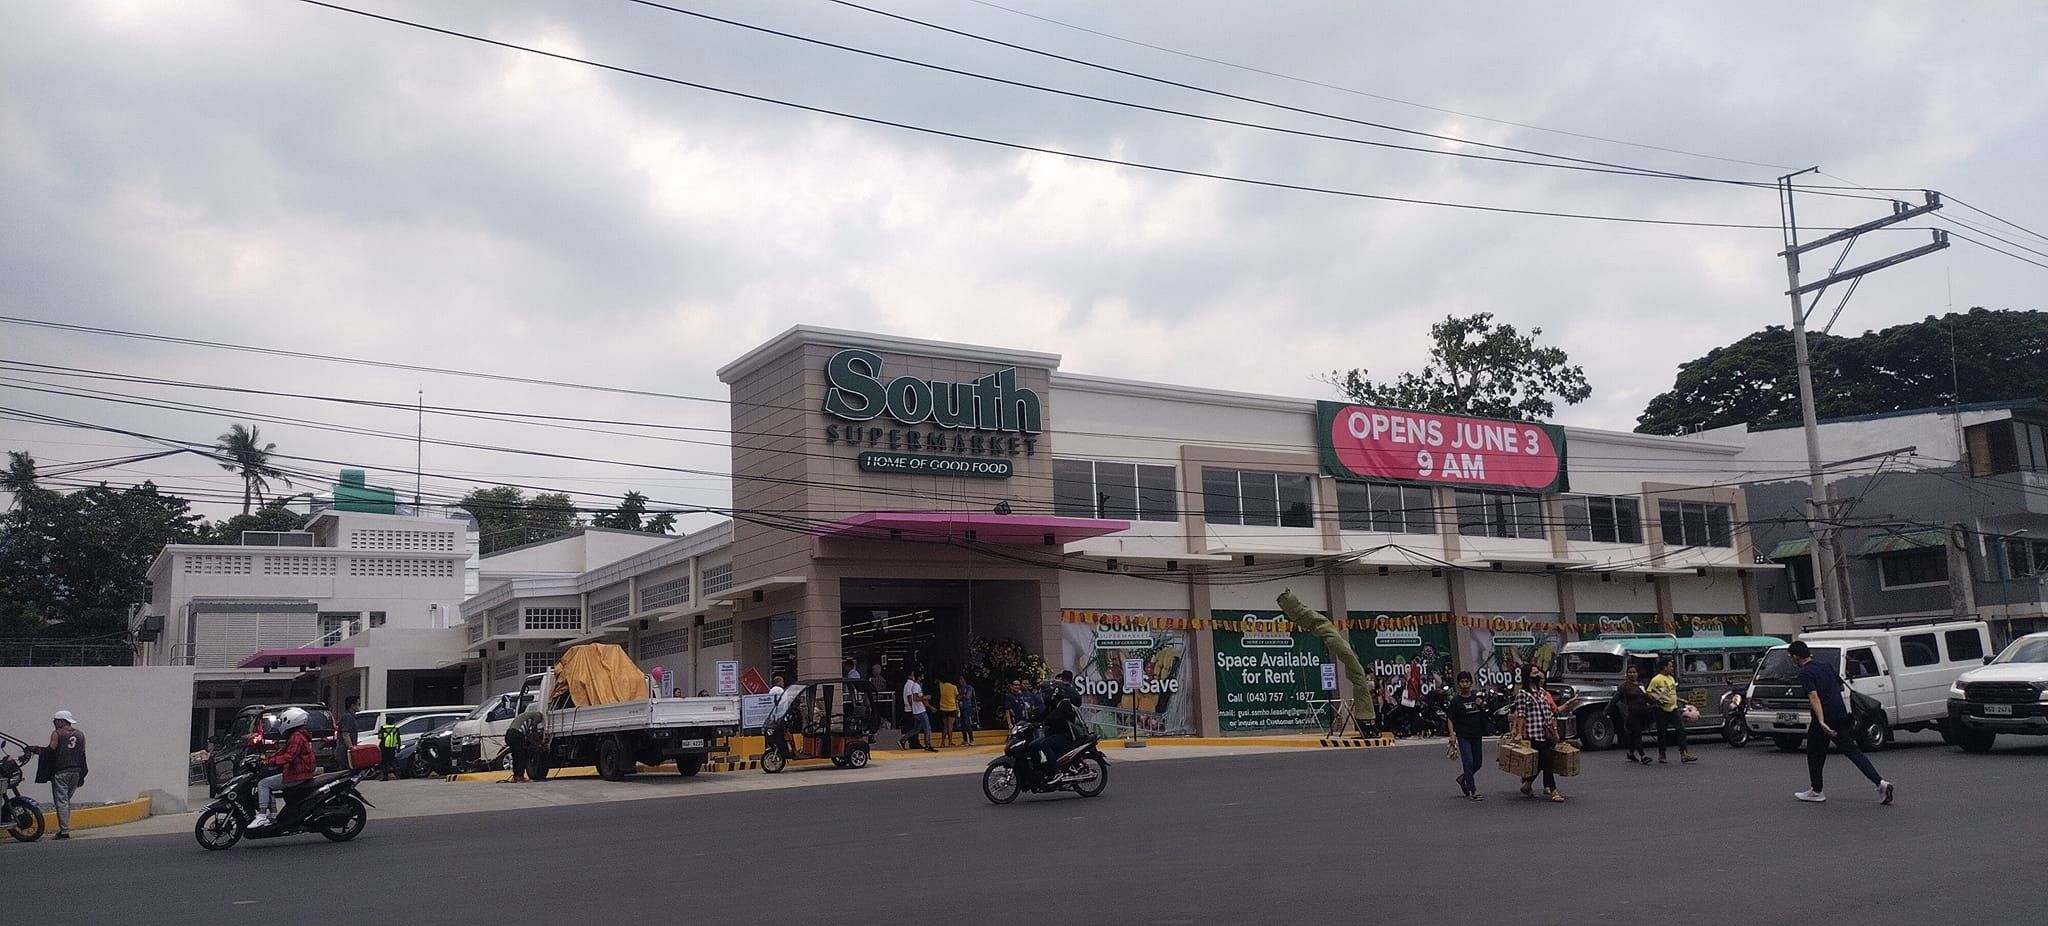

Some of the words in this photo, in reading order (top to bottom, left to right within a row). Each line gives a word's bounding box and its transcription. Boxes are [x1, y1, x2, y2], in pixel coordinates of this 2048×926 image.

[822, 348, 1042, 434] South
[826, 422, 1038, 457] SUPERMARKET
[1348, 412, 1444, 446] OPENS
[1451, 423, 1518, 453] JUNE
[1524, 429, 1540, 456] 3
[867, 456, 908, 469] HOME
[910, 458, 928, 470] OF
[929, 459, 970, 472] GOOD
[972, 461, 1008, 475] FOOD
[1416, 450, 1433, 477] 9
[1442, 453, 1486, 481] AM
[1217, 651, 1257, 671] Space
[1260, 651, 1320, 667] Available
[1374, 660, 1411, 676] Home
[1241, 668, 1261, 684] for
[1264, 668, 1296, 684] Rent
[1478, 667, 1512, 686] Shop
[1074, 675, 1118, 699] Shop
[1140, 676, 1179, 693] Save
[1227, 692, 1243, 703] Call
[1246, 691, 1267, 703] (043)
[1268, 692, 1284, 702] 757
[1296, 691, 1315, 701] 1877
[67, 736, 77, 749] 3
